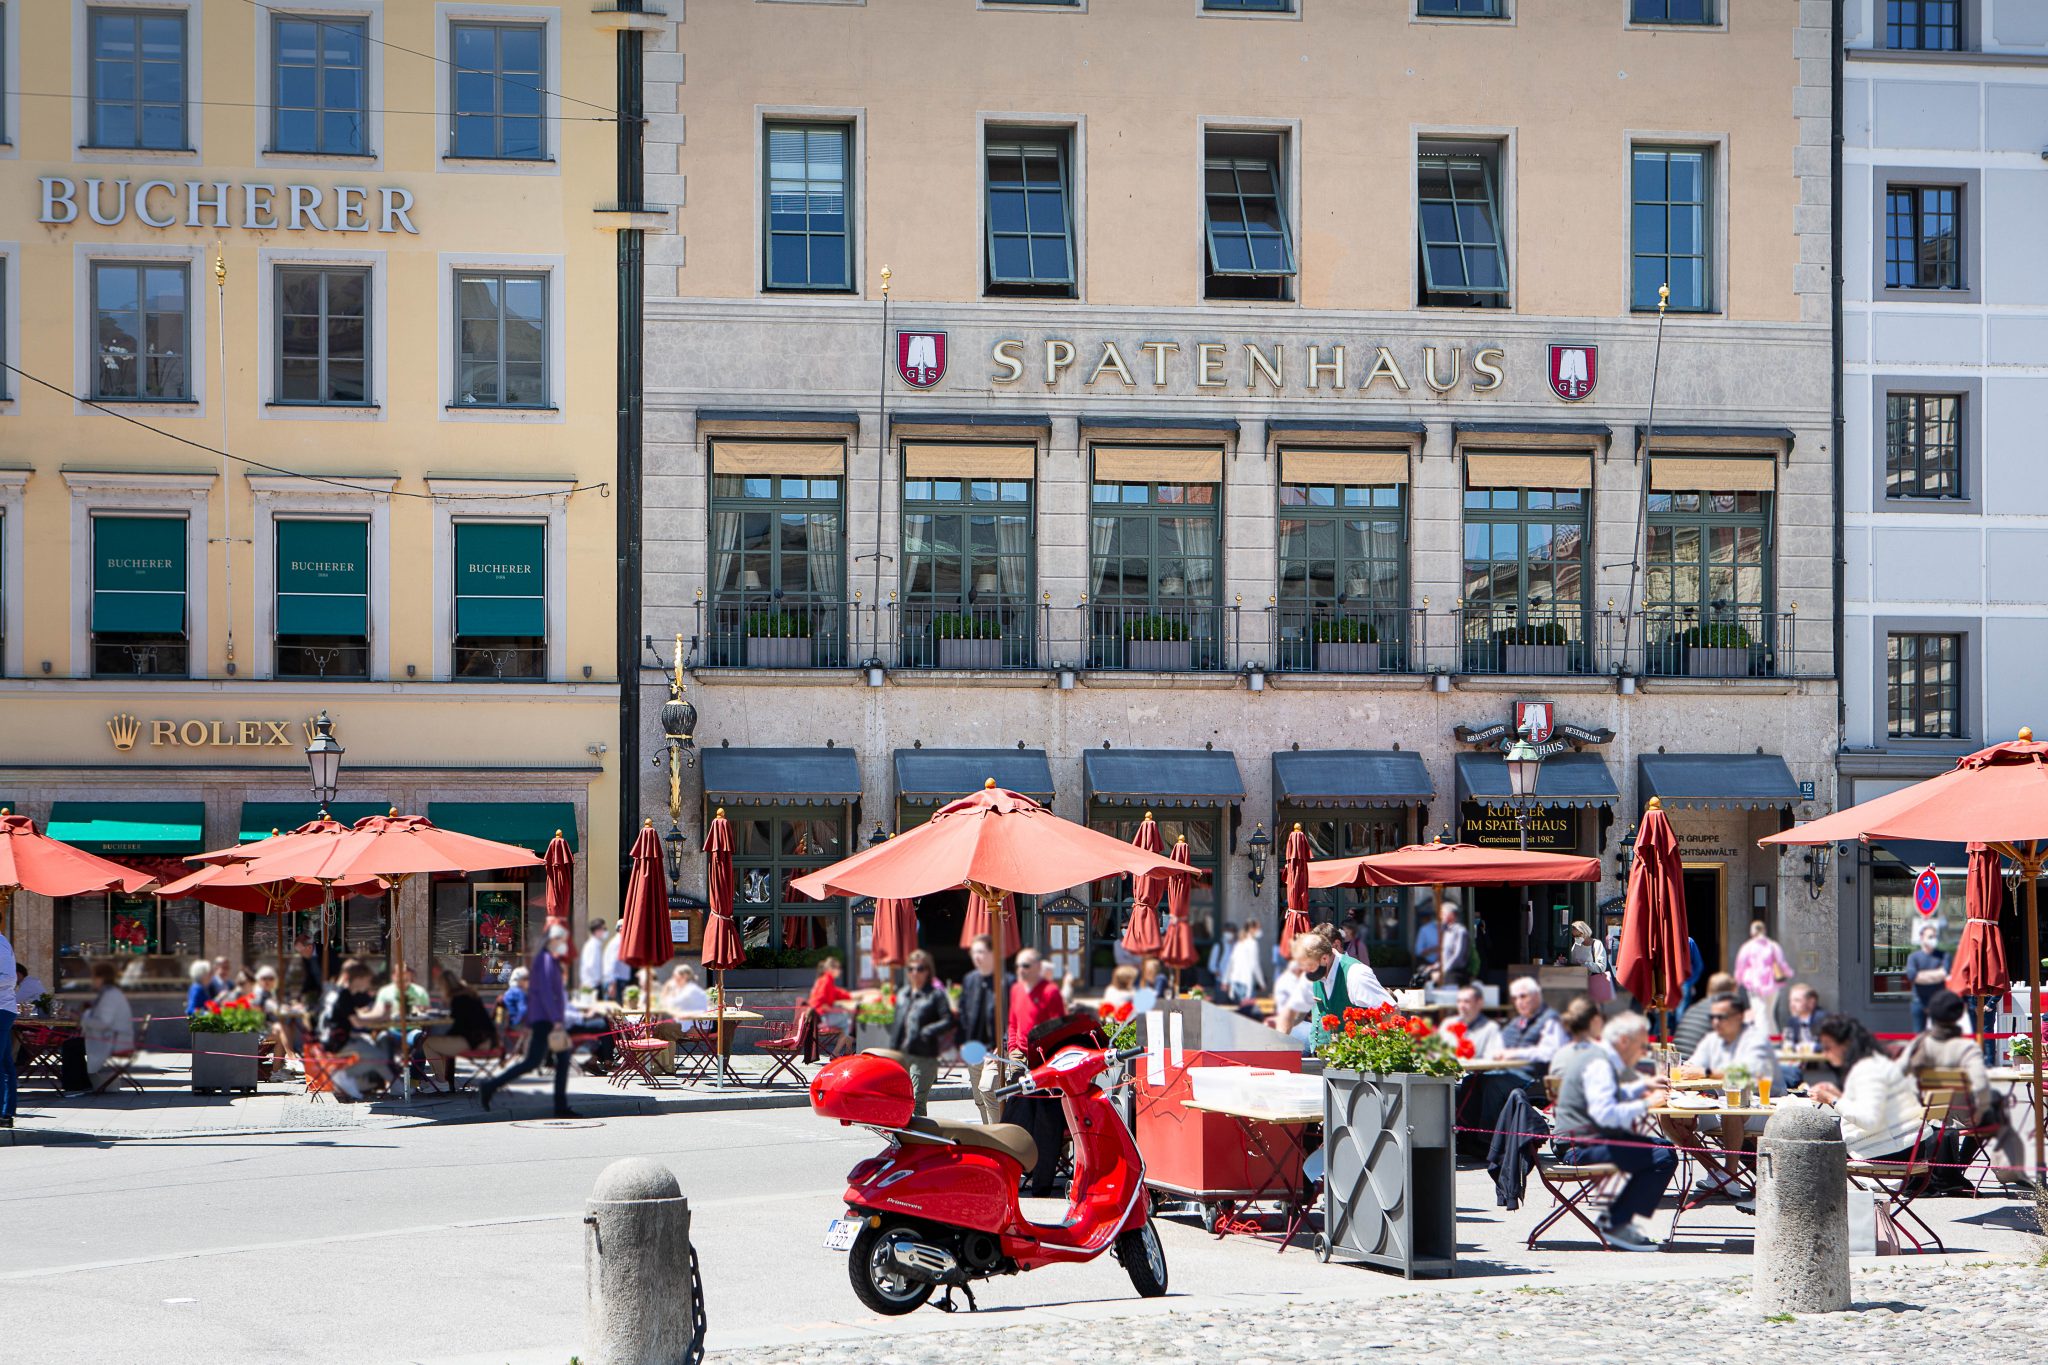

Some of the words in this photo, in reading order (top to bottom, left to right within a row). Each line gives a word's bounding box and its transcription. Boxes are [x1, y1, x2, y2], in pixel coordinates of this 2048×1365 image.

[37, 176, 420, 234] BUCHERER
[990, 339, 1505, 393] SPATENHAUS
[906, 369, 916, 379] G
[927, 369, 937, 379] S
[1558, 382, 1568, 391] G
[1579, 382, 1587, 392] S
[107, 558, 173, 568] BUCHERER
[291, 561, 354, 571] BUCHERER
[469, 563, 531, 574] BUCHERER
[150, 719, 294, 747] ROLEX
[1466, 725, 1505, 743] BRÄUSTUBEN
[1564, 726, 1601, 743] RESTAURANT
[1803, 782, 1813, 792] 12
[1487, 806, 1546, 817] KUFFER
[1467, 820, 1483, 831] IM
[1478, 835, 1521, 843] Gemeinsam
[1537, 835, 1555, 843] 1982
[1686, 834, 1720, 843] GRUPPE
[1680, 848, 1738, 857] CHTSANWÄLTE
